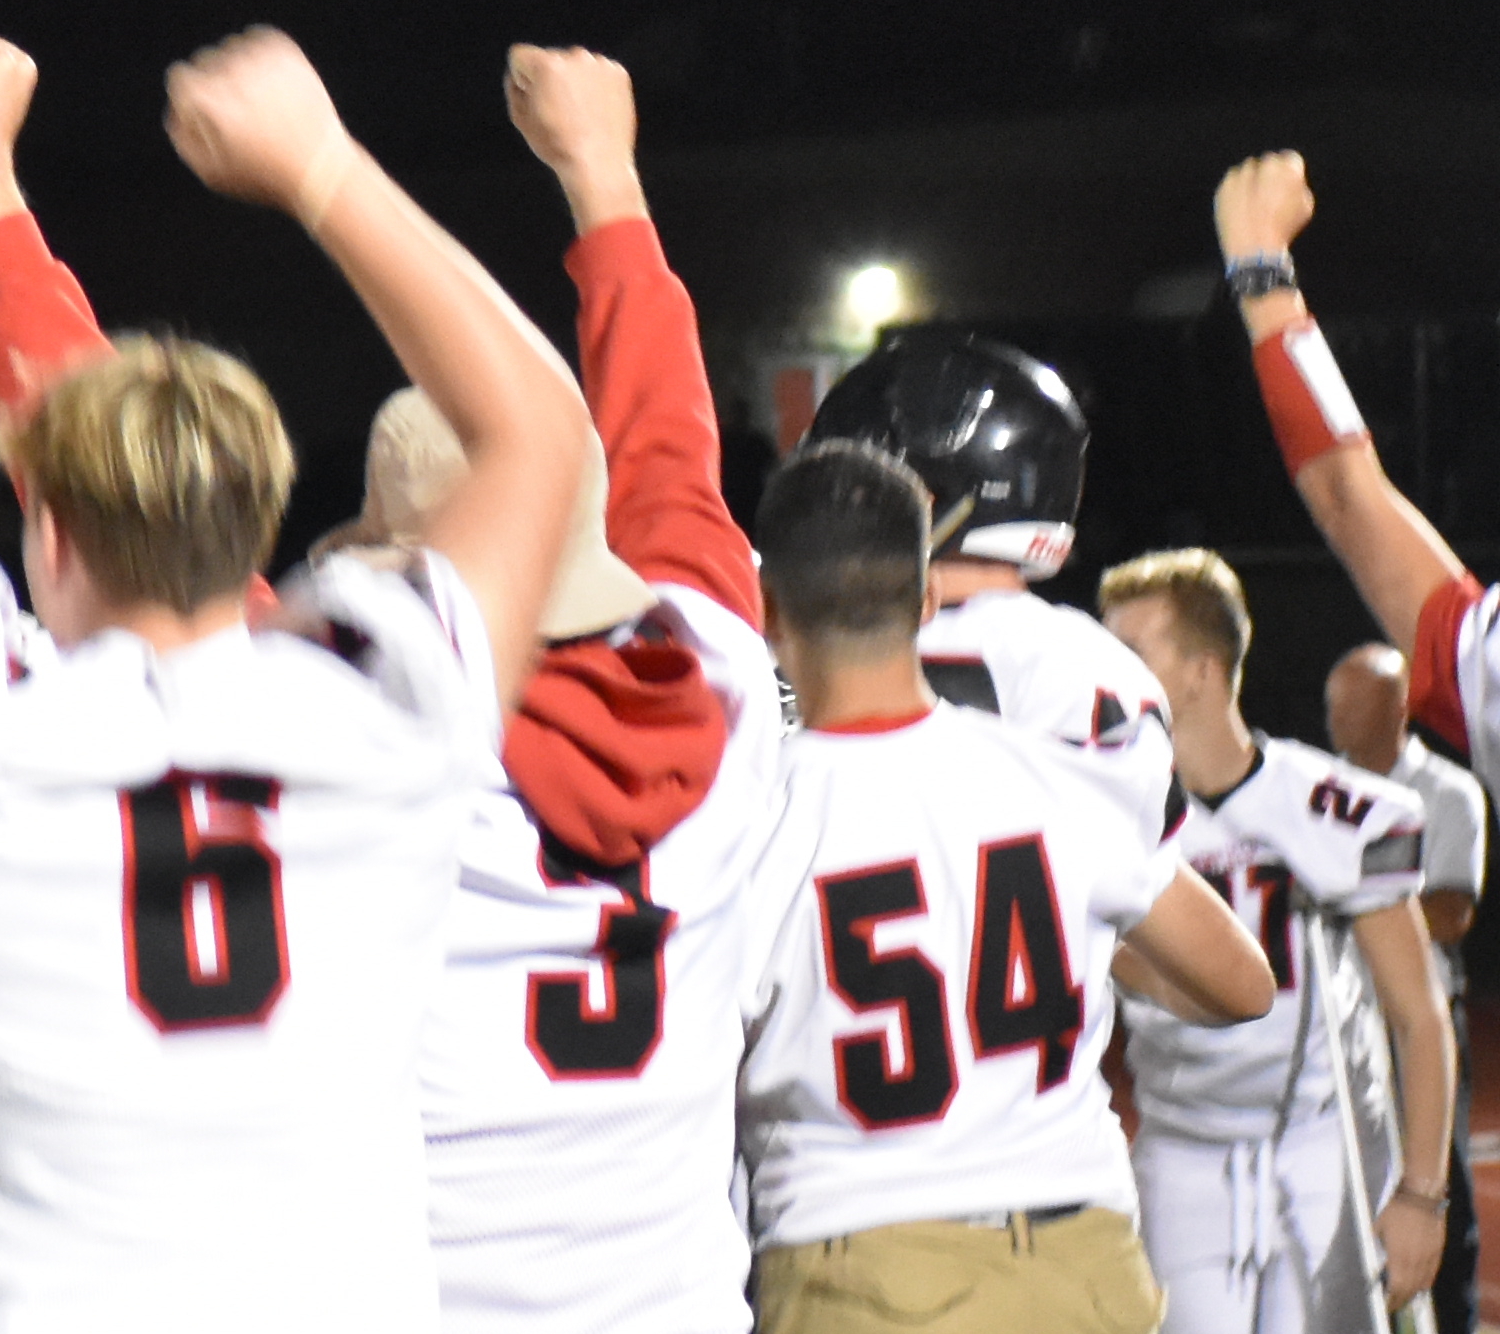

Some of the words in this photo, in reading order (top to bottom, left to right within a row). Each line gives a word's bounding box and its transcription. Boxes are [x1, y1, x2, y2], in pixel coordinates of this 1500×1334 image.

[117, 767, 292, 1034] 6
[524, 825, 678, 1081] 3
[812, 831, 1085, 1133] 54
